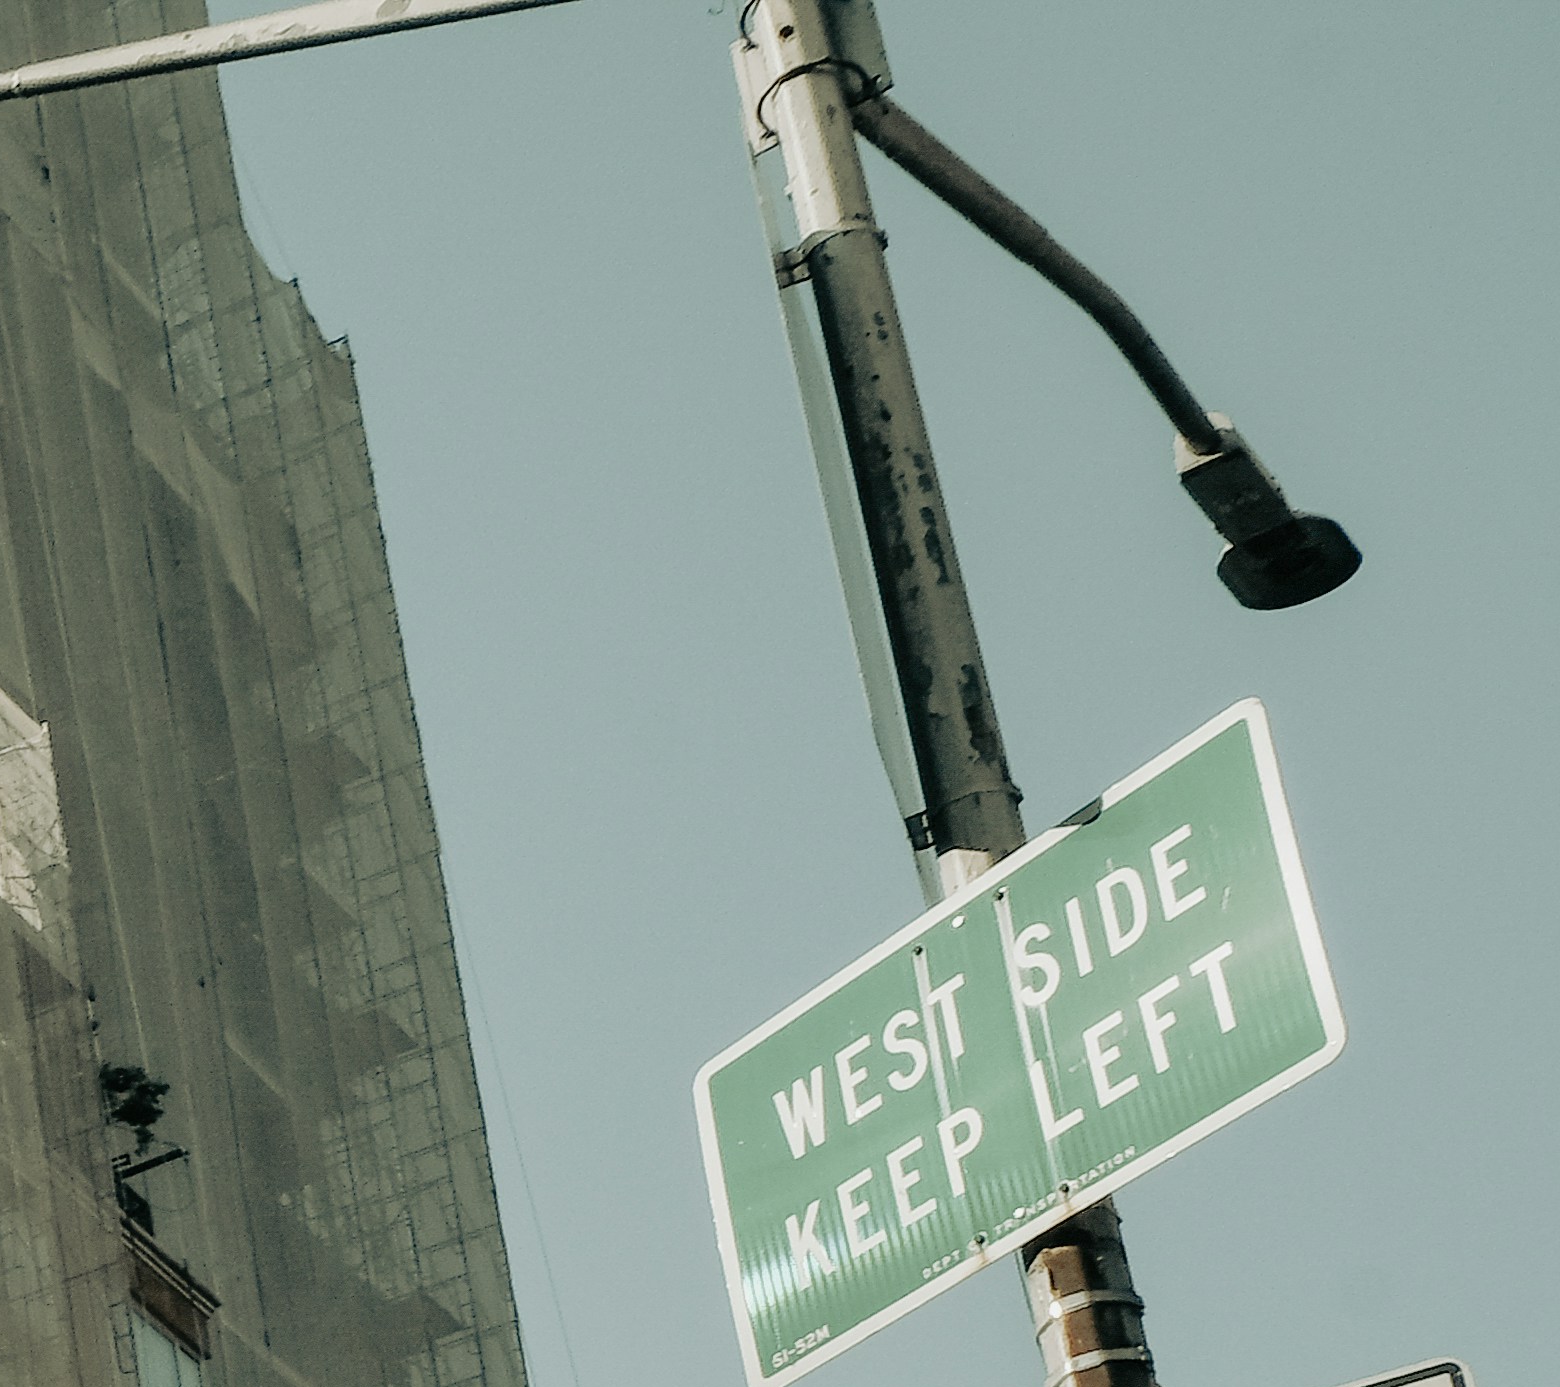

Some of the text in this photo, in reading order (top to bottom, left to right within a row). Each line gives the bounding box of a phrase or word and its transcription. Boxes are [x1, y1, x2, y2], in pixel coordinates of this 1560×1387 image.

[772, 822, 1207, 1160] WEST SIDE
[784, 941, 1235, 1292] KEEP LEFT
[993, 1146, 1136, 1236] TRNSPRTATION
